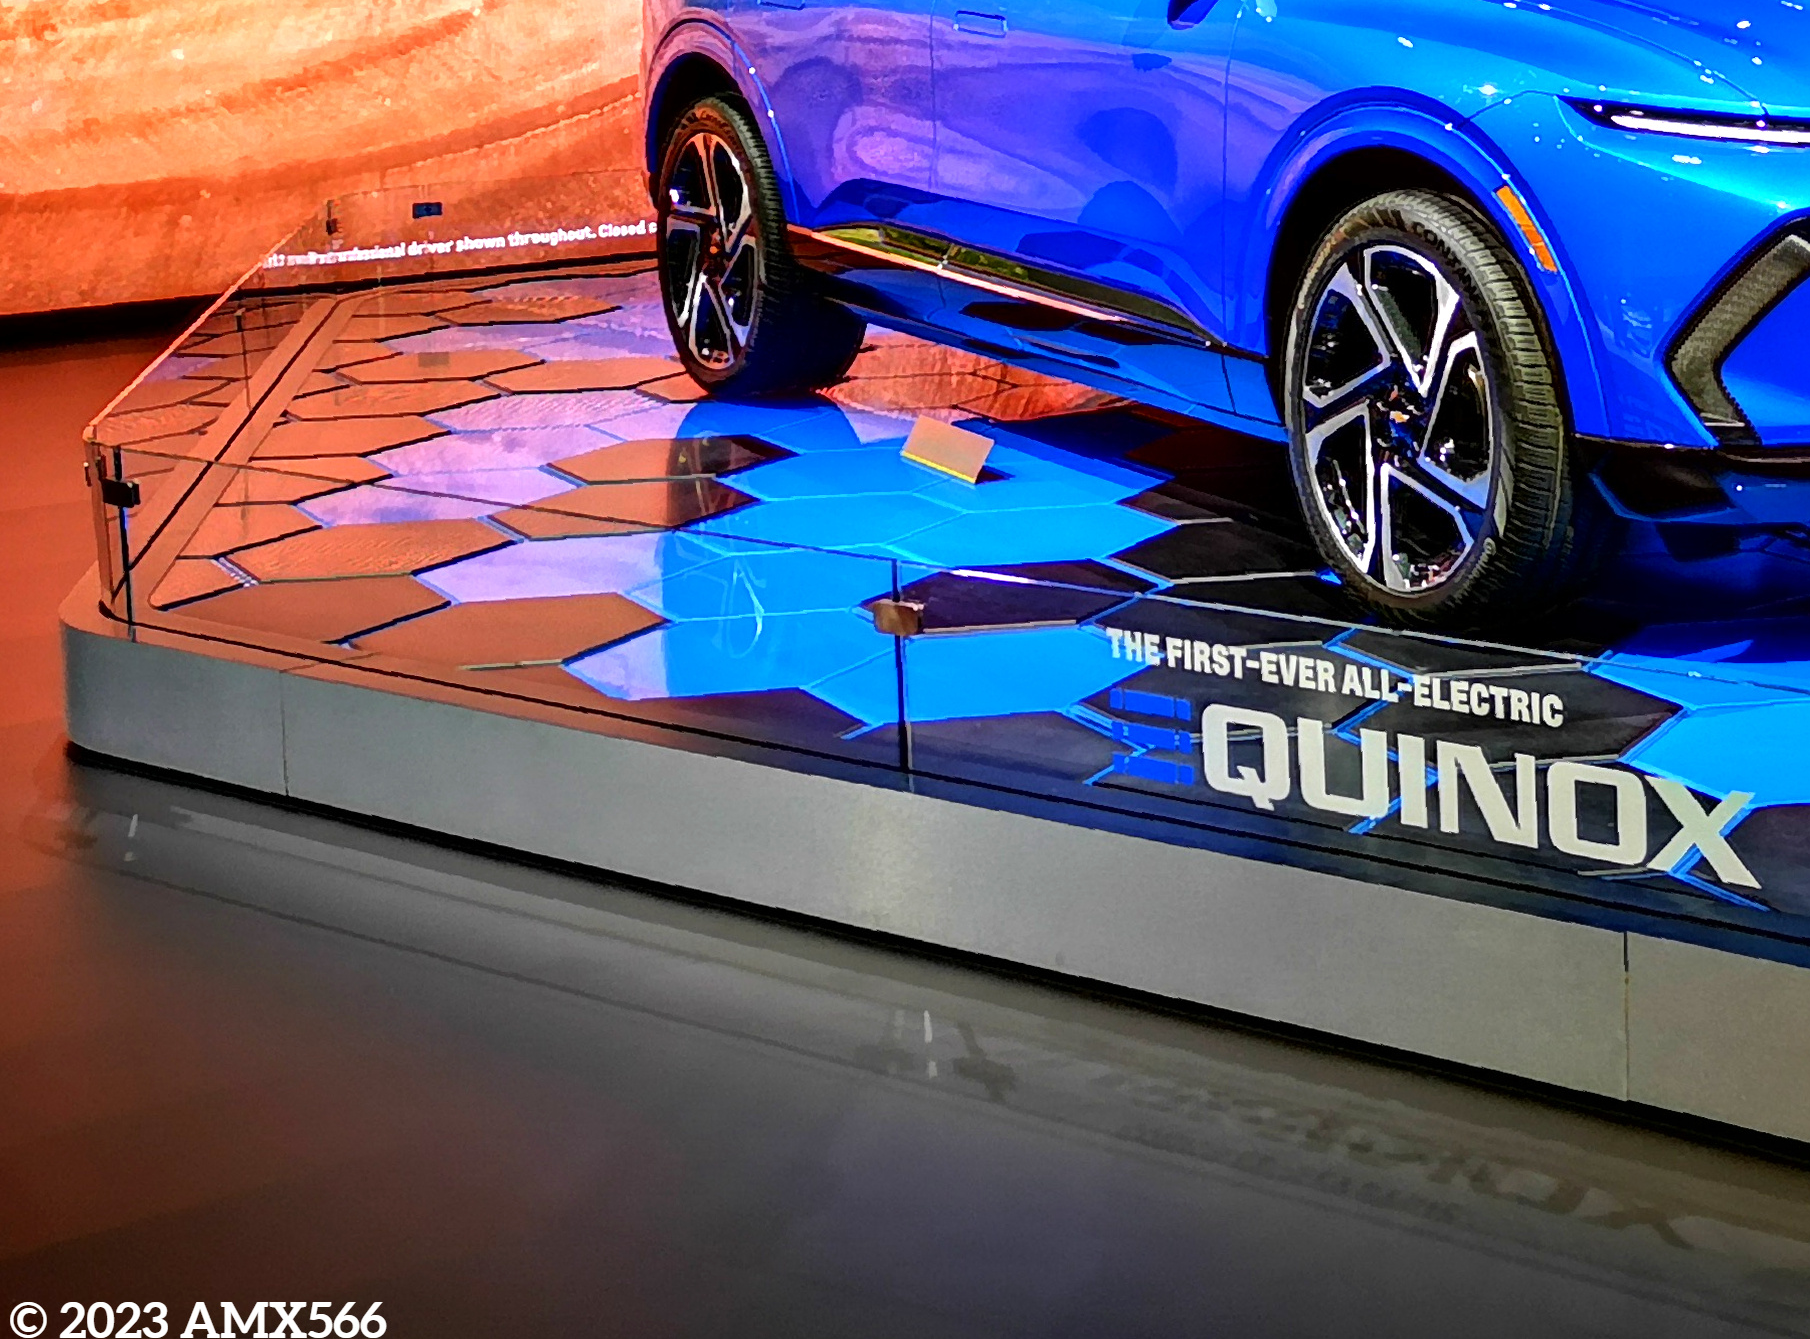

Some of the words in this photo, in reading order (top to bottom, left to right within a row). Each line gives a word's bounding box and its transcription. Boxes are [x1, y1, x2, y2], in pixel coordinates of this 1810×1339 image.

[408, 239, 452, 257] driver
[456, 235, 505, 254] shown
[508, 225, 597, 248] throughout.
[598, 219, 647, 239] Closed
[1106, 626, 1162, 664] THE
[1166, 635, 1338, 694] FIRST-EVER
[1341, 668, 1565, 729] ALL-ELECTRIC
